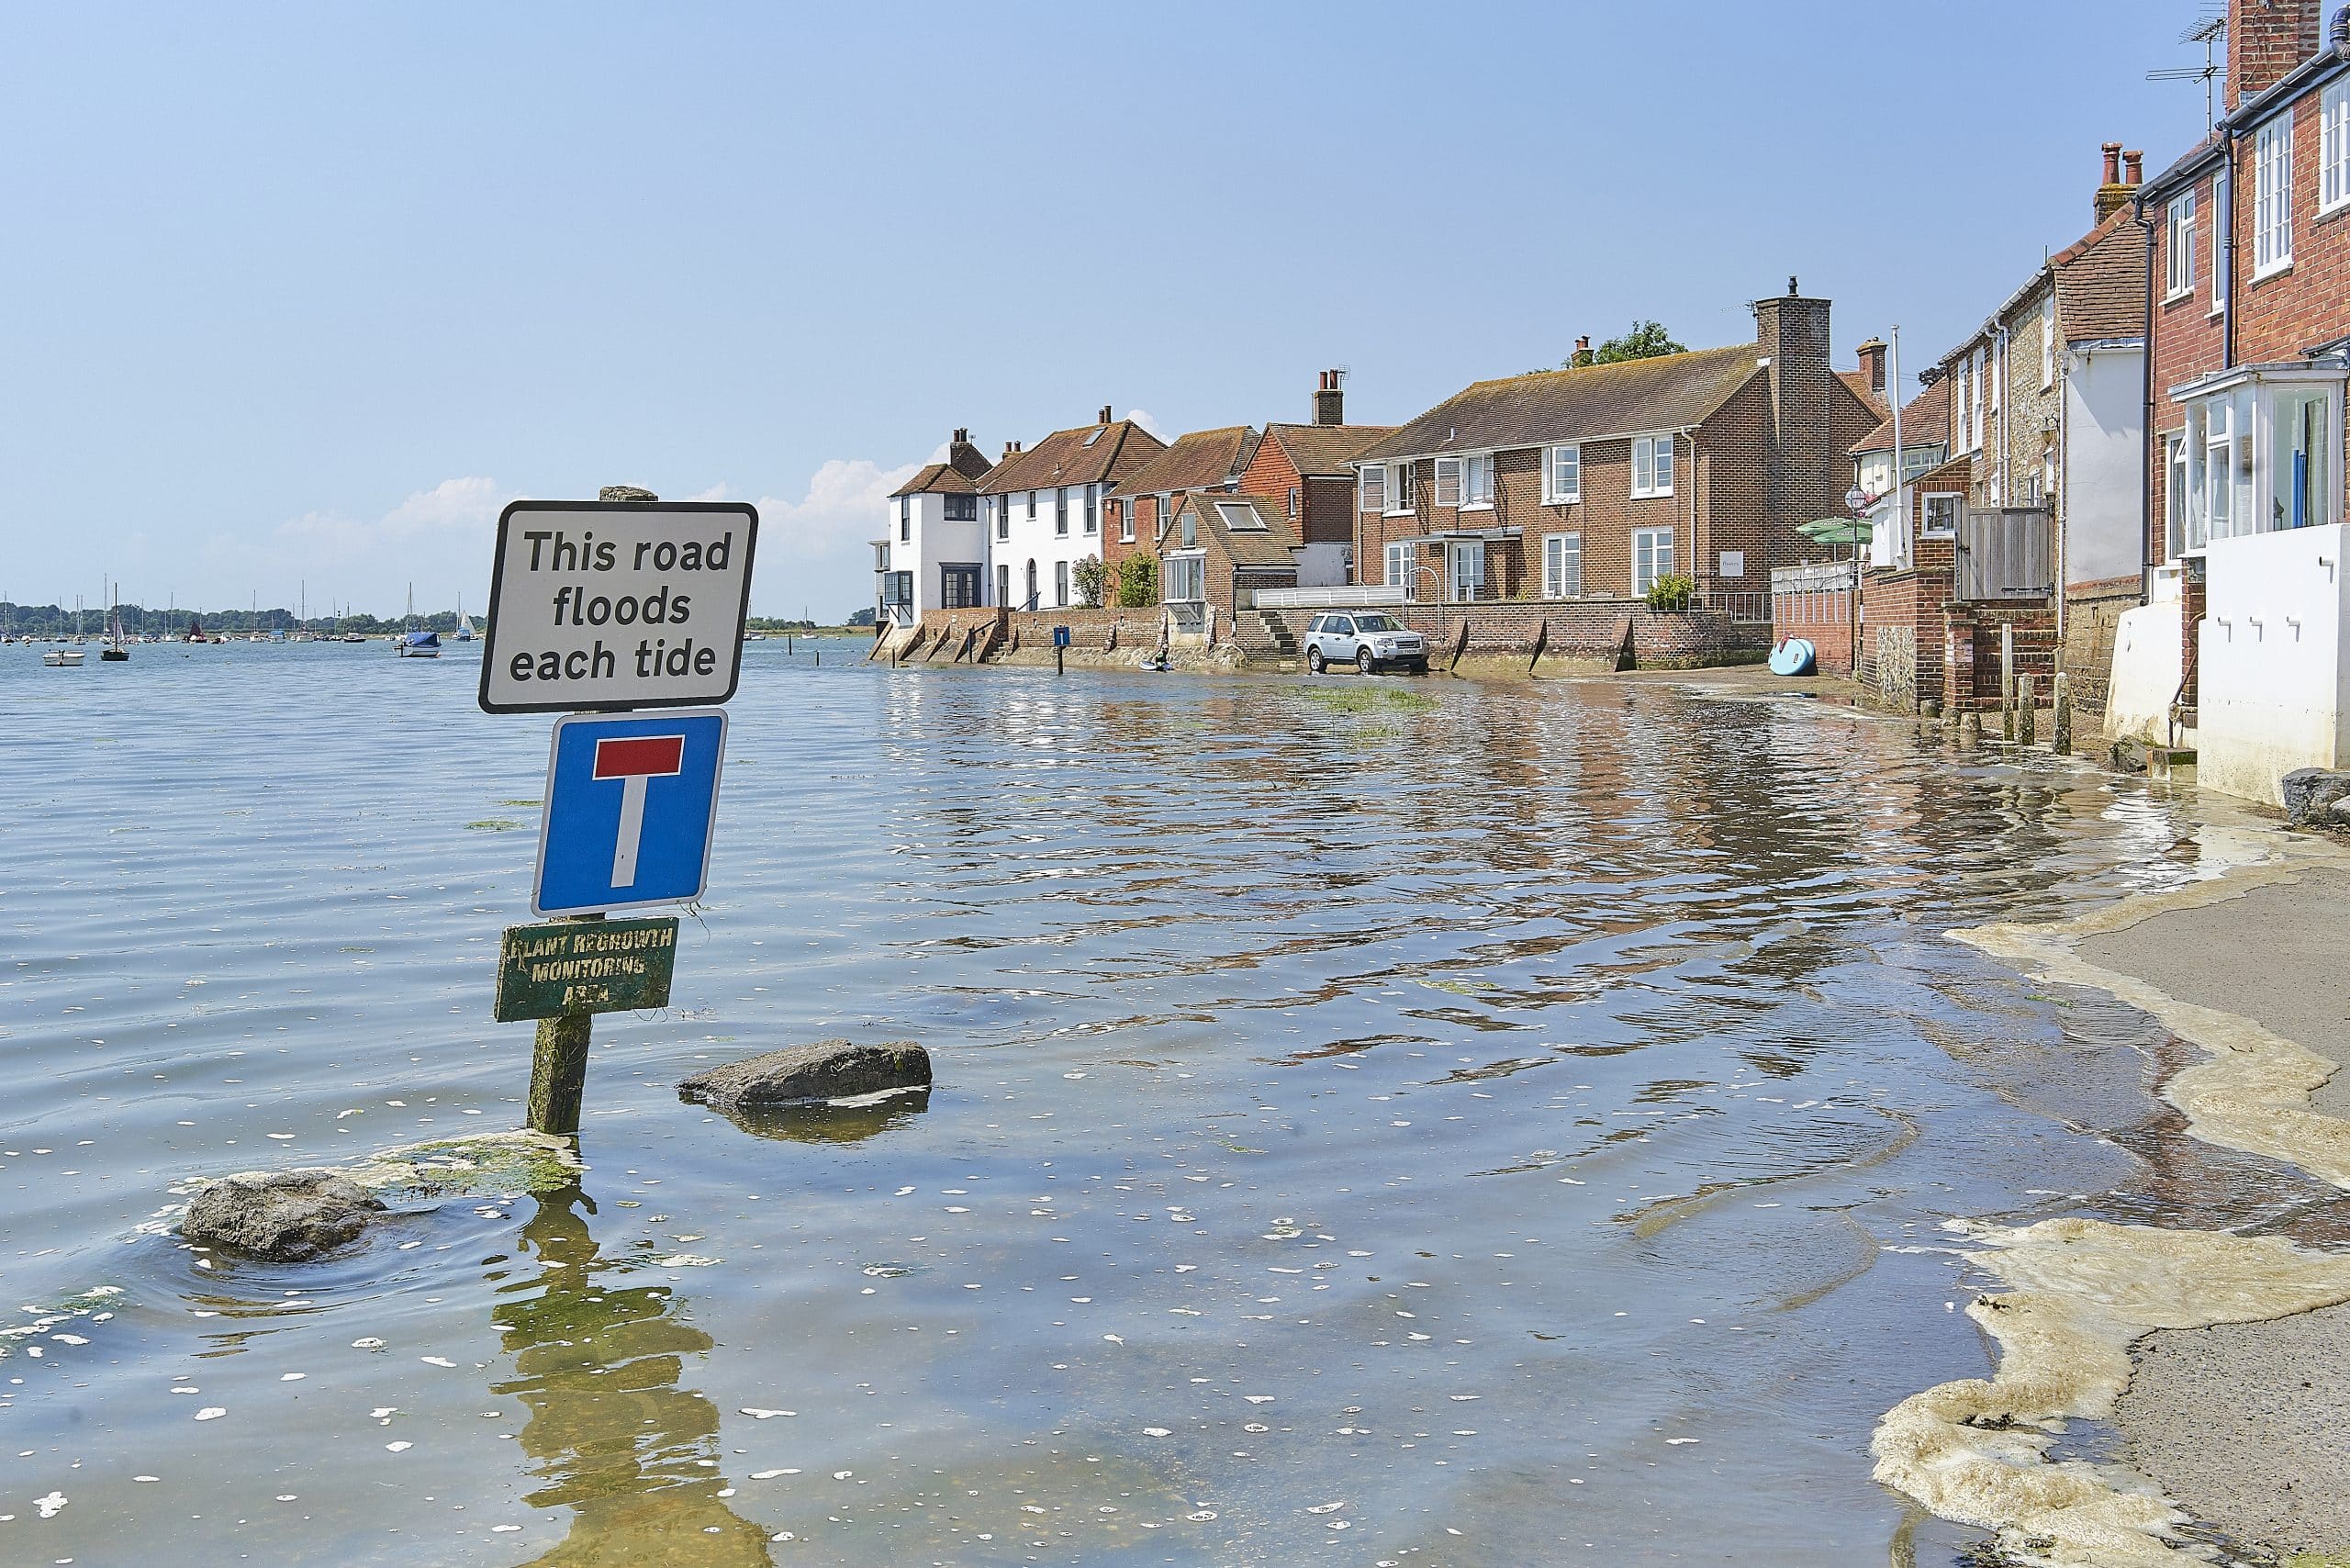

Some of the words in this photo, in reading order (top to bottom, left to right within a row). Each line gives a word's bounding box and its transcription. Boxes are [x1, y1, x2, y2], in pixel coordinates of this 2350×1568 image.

[524, 531, 617, 571] This
[633, 532, 732, 571] road
[553, 586, 690, 626] floods
[509, 640, 615, 681] each
[634, 638, 716, 678] tide
[573, 927, 673, 954] REGROWTH
[532, 956, 645, 983] MONITORING
